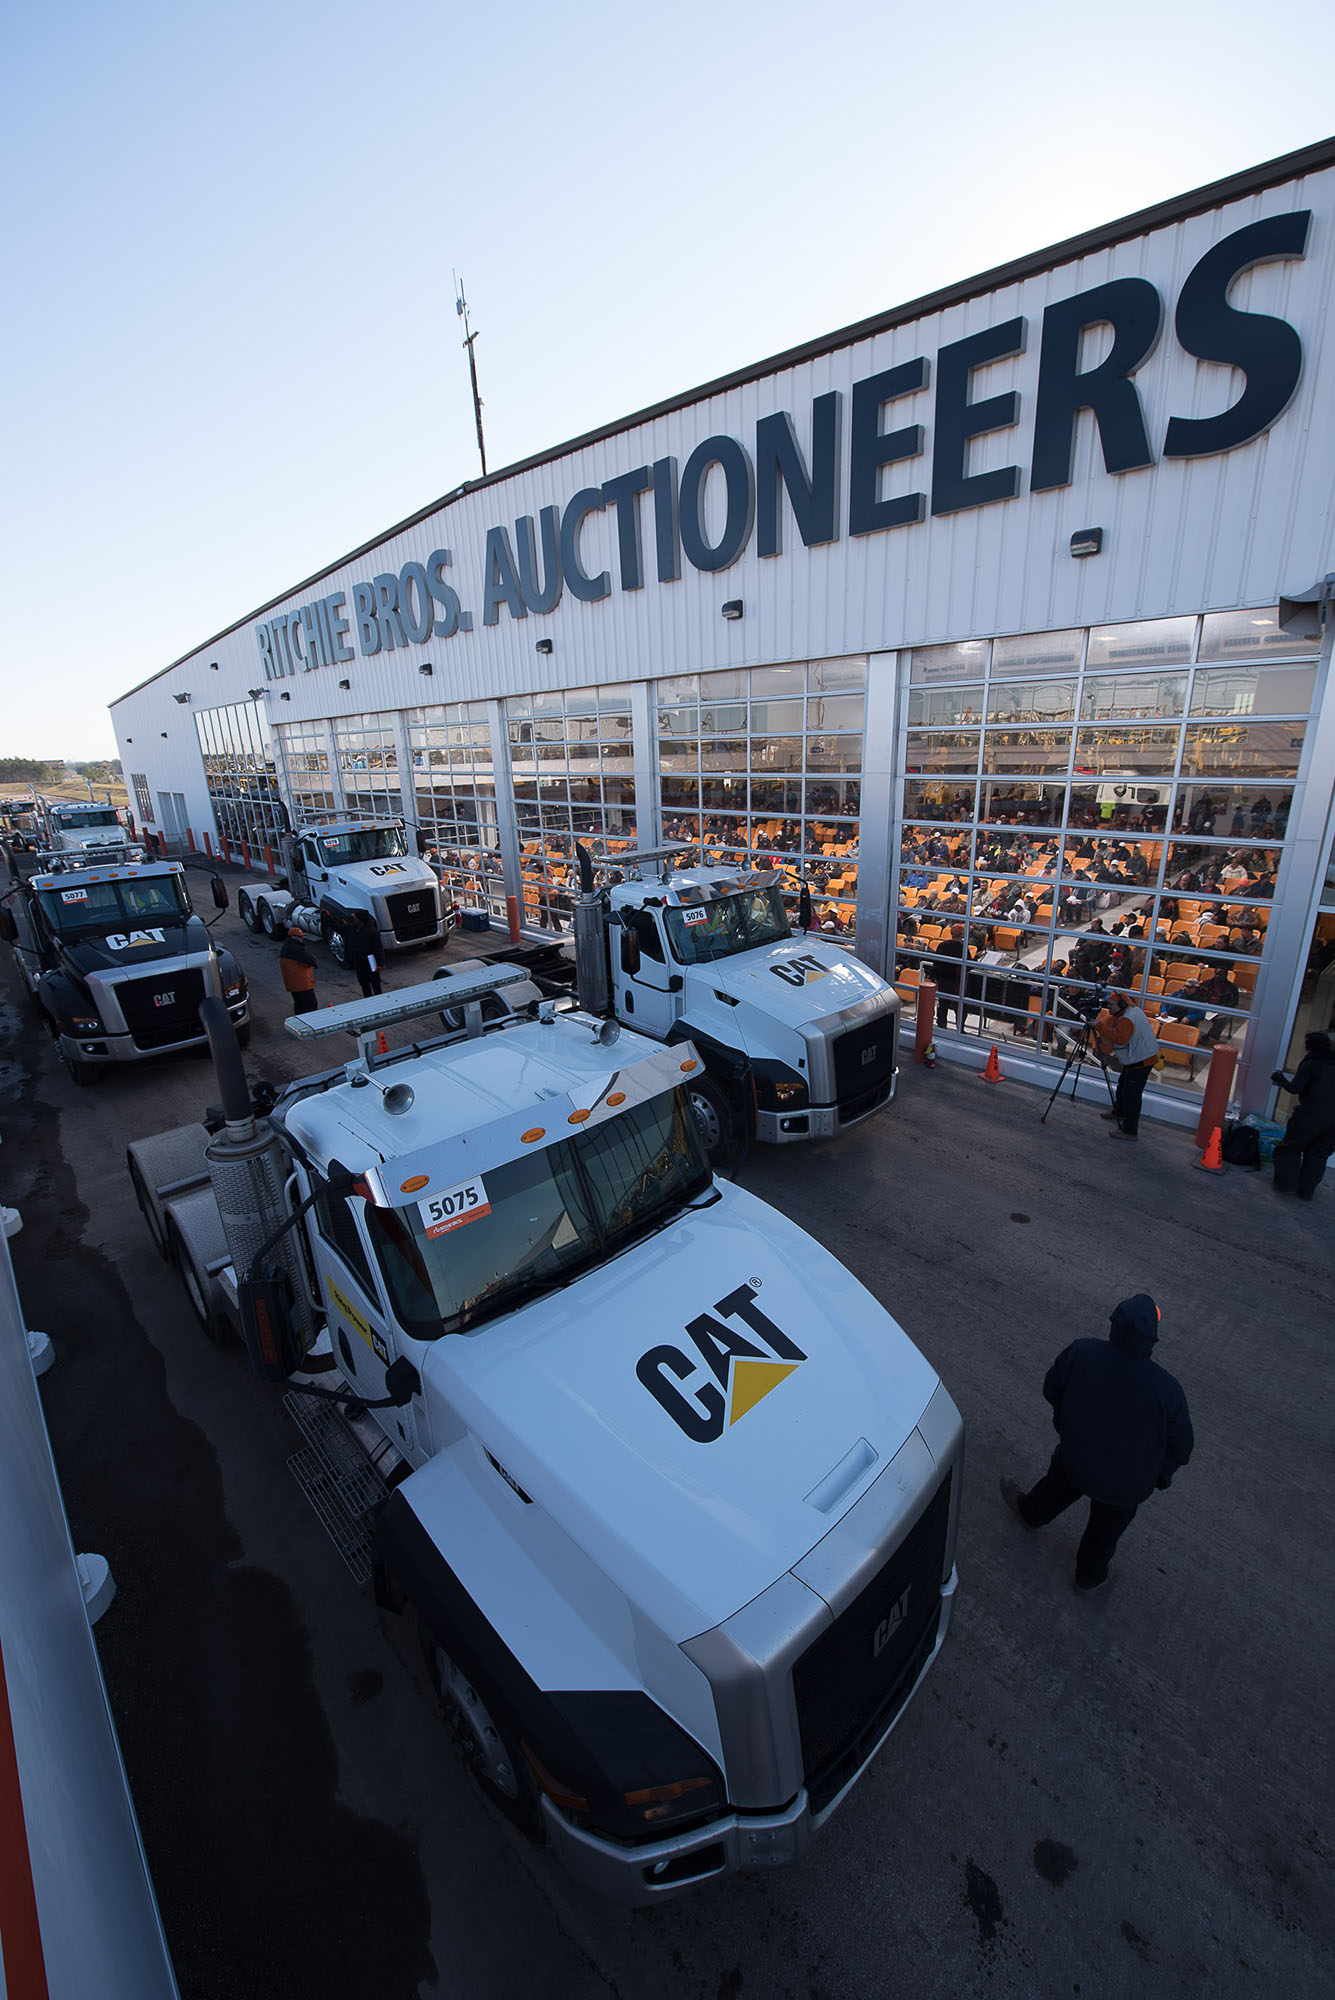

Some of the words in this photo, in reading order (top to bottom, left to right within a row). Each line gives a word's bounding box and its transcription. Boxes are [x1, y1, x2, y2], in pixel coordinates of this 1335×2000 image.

[255, 591, 355, 681] RITCHIE
[352, 548, 473, 656] BROS.
[482, 209, 1313, 628] AUCTIONEERS
[369, 862, 408, 876] CAT
[64, 890, 84, 900] 5077
[407, 903, 420, 914] CAT
[685, 909, 704, 921] 5076
[105, 927, 166, 950] CAT
[769, 954, 832, 987] CAT
[153, 991, 176, 1008] CAT
[861, 1045, 878, 1066] CAT
[428, 1186, 479, 1221] 5075
[636, 1284, 808, 1444] CAT
[873, 1583, 912, 1659] CAT
